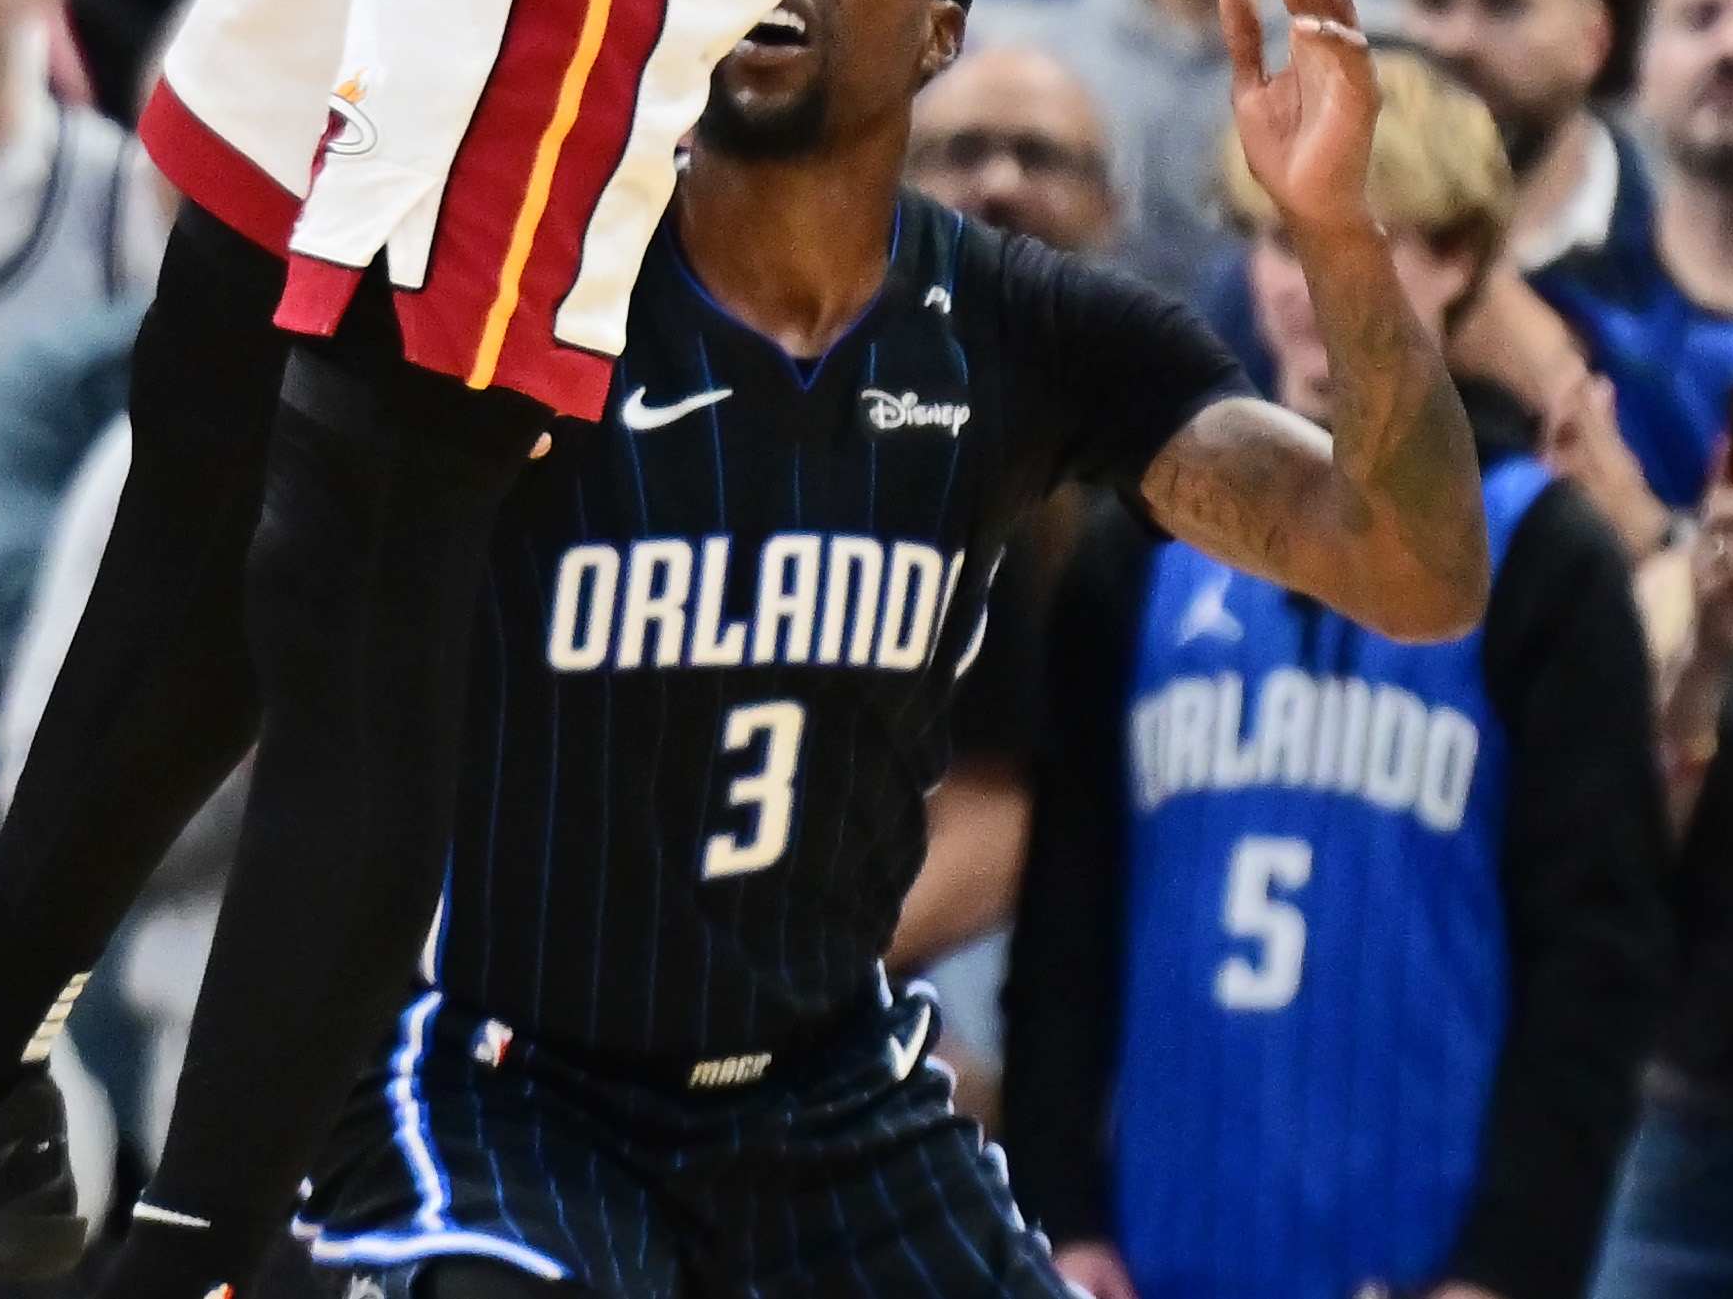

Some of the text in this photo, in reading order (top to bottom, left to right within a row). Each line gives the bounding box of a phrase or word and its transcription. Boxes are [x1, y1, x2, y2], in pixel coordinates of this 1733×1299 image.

[860, 388, 971, 439] Disney
[545, 529, 966, 674] ORLAND
[699, 698, 807, 882] 3
[1211, 833, 1313, 1010] 5
